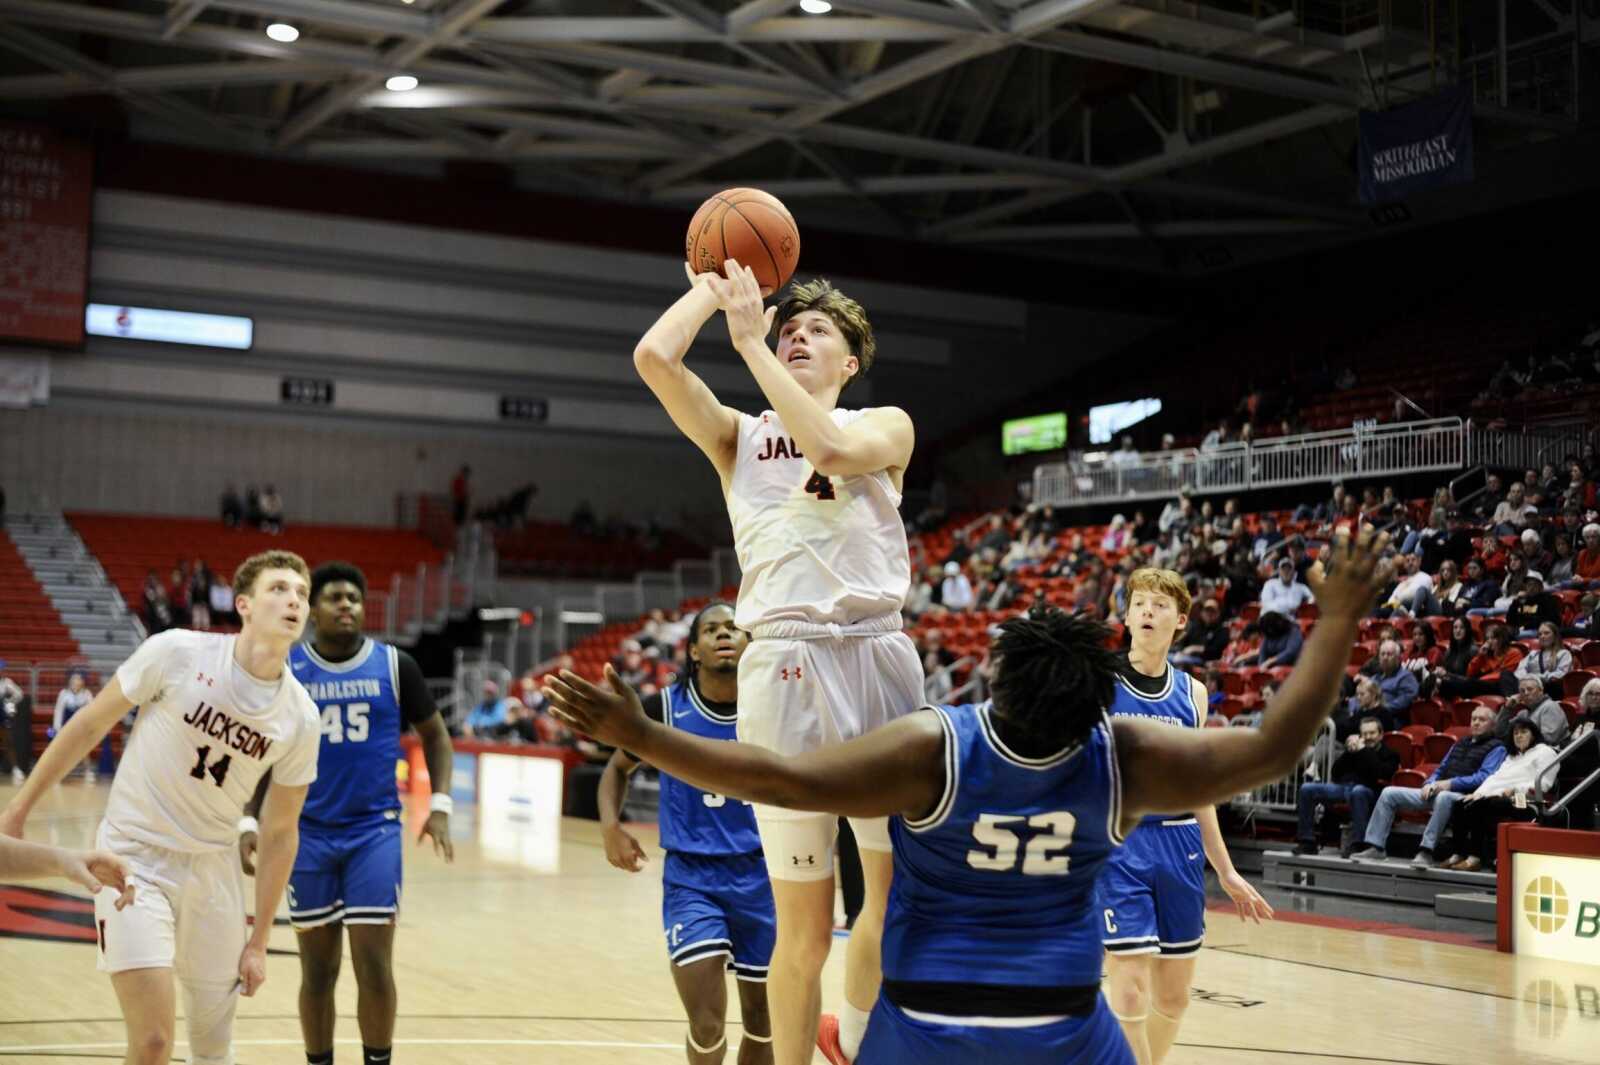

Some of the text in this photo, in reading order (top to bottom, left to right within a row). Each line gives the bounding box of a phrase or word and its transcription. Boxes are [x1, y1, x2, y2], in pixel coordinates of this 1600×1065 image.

[1373, 147, 1457, 182] MISSOURIAN
[804, 469, 836, 500] 4
[183, 701, 273, 761] JACKSON
[321, 702, 370, 744] 45
[190, 745, 232, 788] 14
[966, 811, 1076, 875] 52
[1104, 908, 1117, 934] C
